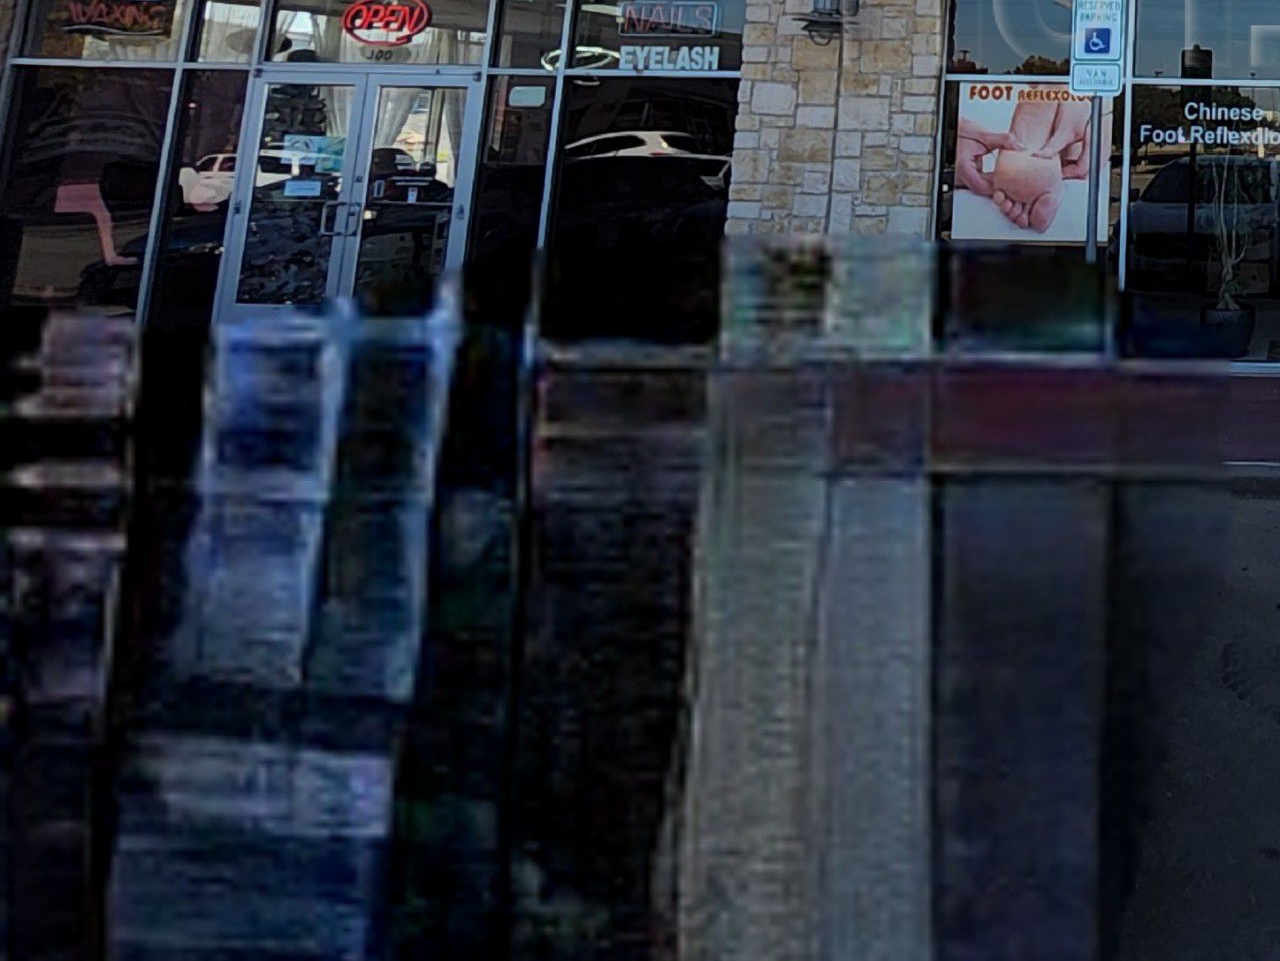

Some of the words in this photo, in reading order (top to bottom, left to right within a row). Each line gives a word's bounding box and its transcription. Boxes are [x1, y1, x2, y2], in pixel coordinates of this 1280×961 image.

[1077, 0, 1120, 11] RESERVED
[345, 3, 421, 33] OPEN
[624, 4, 713, 33] NAILS
[1079, 11, 1118, 22] PARKING
[619, 45, 721, 70] EYELASH
[1086, 69, 1108, 78] VAN
[968, 84, 1014, 101] FOOT
[1184, 101, 1264, 121] Chinese
[1140, 125, 1185, 144] Foot
